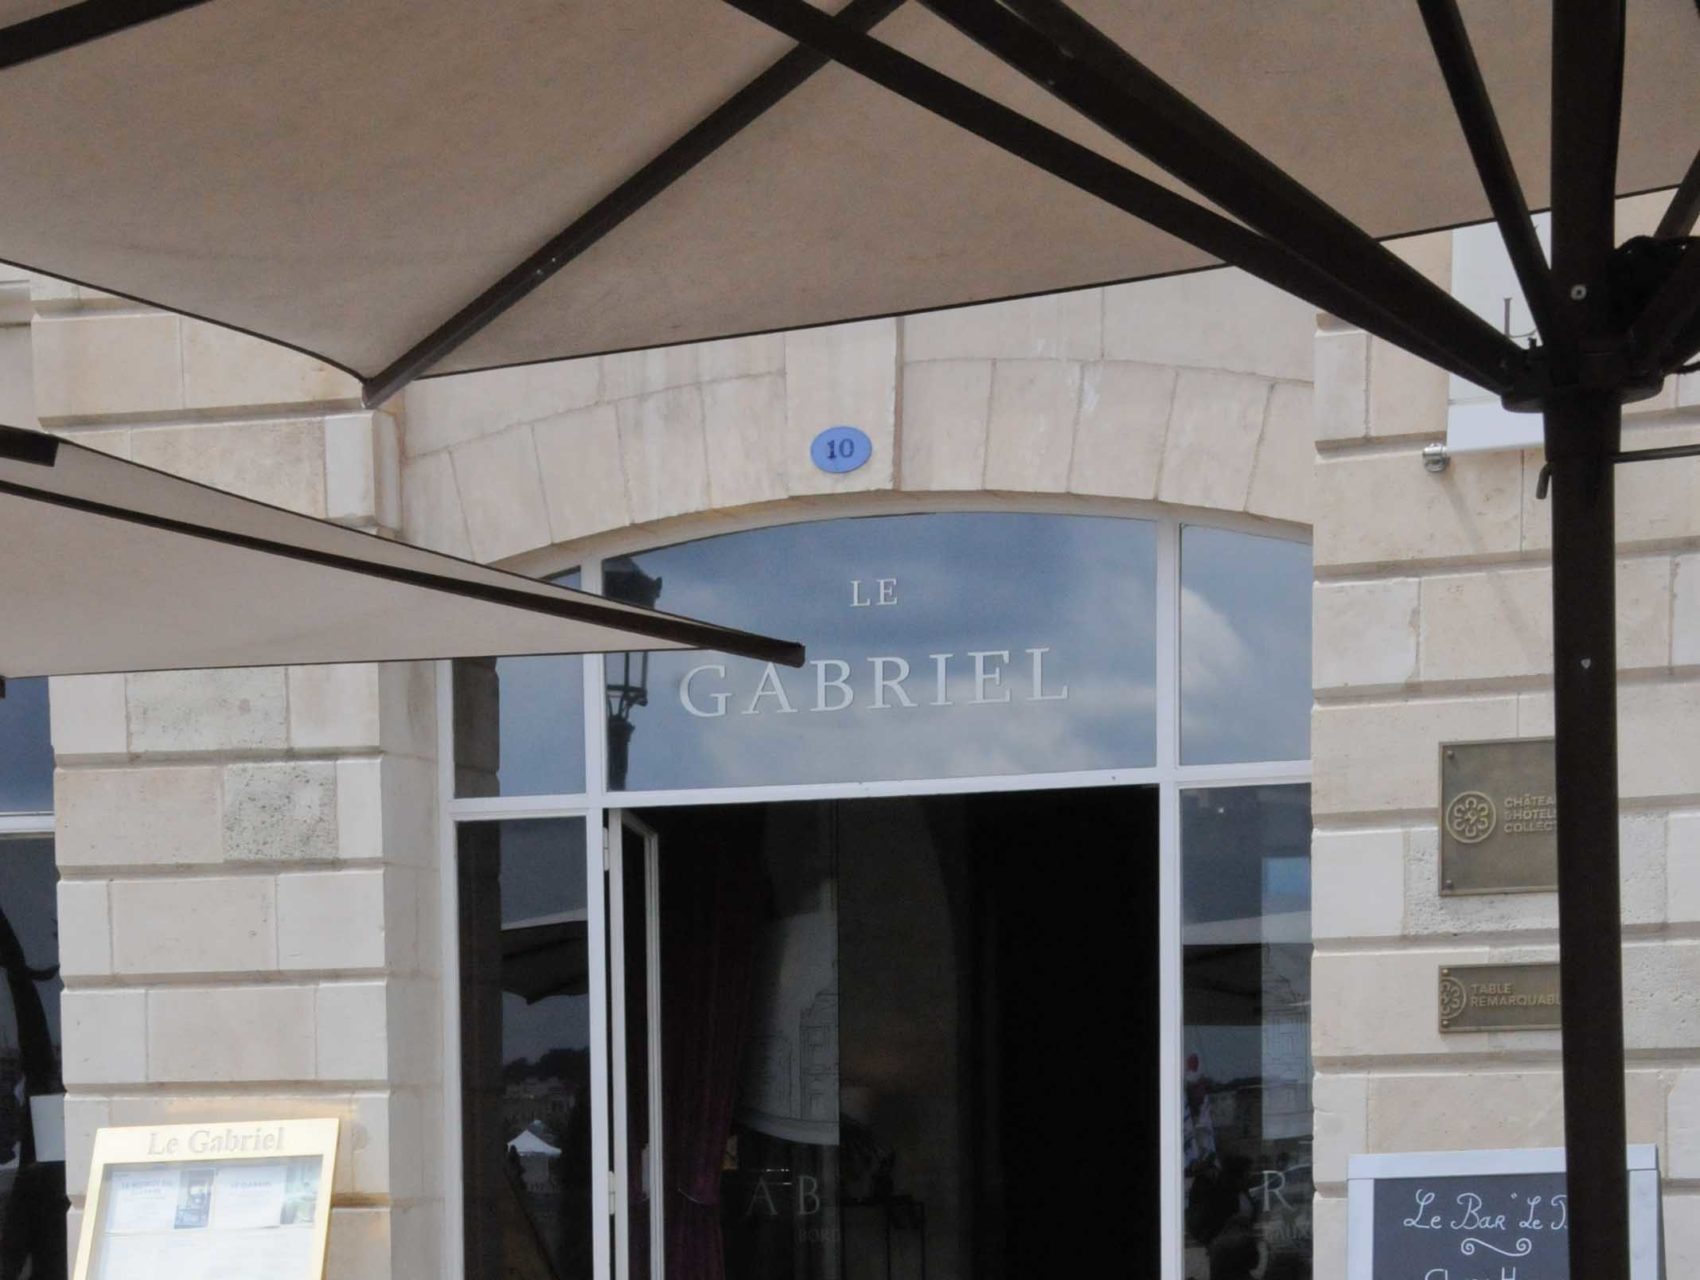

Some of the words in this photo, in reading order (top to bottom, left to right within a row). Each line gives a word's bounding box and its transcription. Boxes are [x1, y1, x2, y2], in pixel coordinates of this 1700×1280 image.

[827, 437, 856, 460] 10
[850, 578, 898, 607] LE
[679, 647, 1069, 718] GABRIEL
[1470, 983, 1513, 994] TABLE
[147, 1131, 178, 1155] Le
[188, 1126, 287, 1153] Gabriel
[1403, 1189, 1442, 1229] Le
